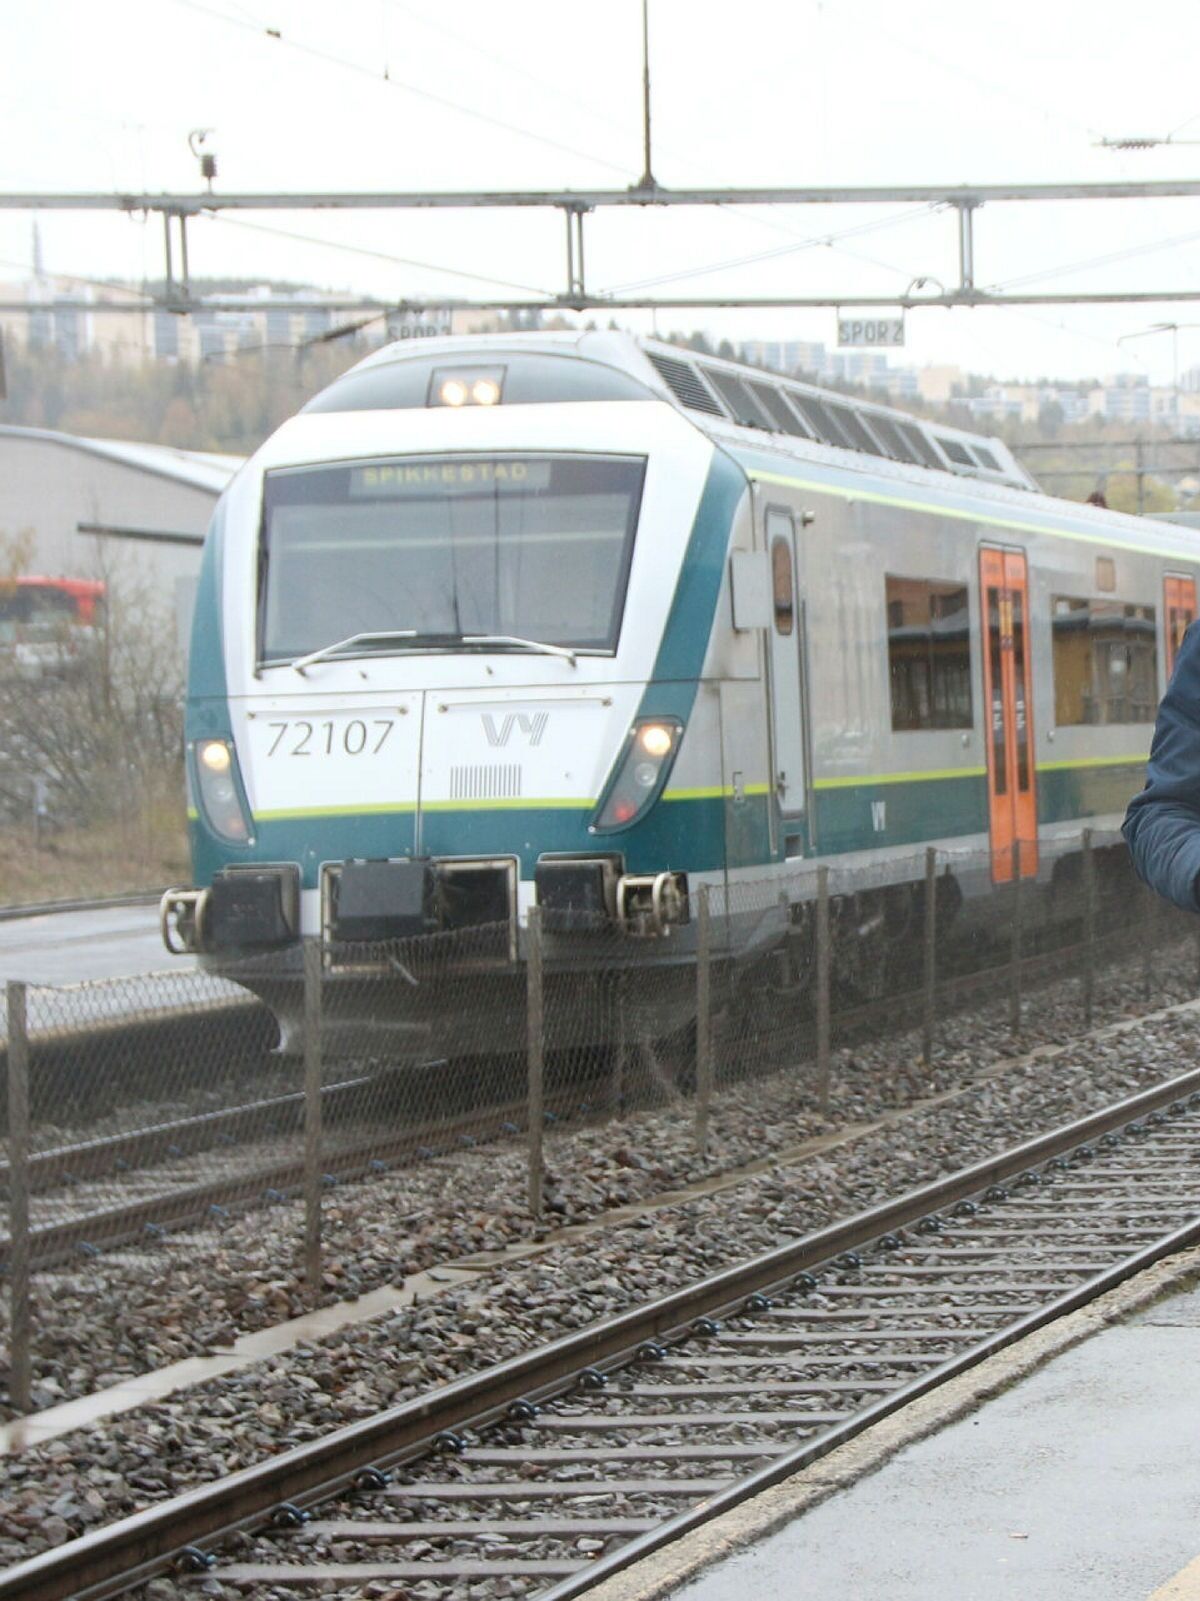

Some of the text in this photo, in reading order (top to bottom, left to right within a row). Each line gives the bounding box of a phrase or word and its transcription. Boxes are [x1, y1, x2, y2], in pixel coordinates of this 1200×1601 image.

[838, 320, 904, 343] SPOR 2
[363, 461, 529, 486] SPIKKESTAD
[267, 719, 395, 757] 72107
